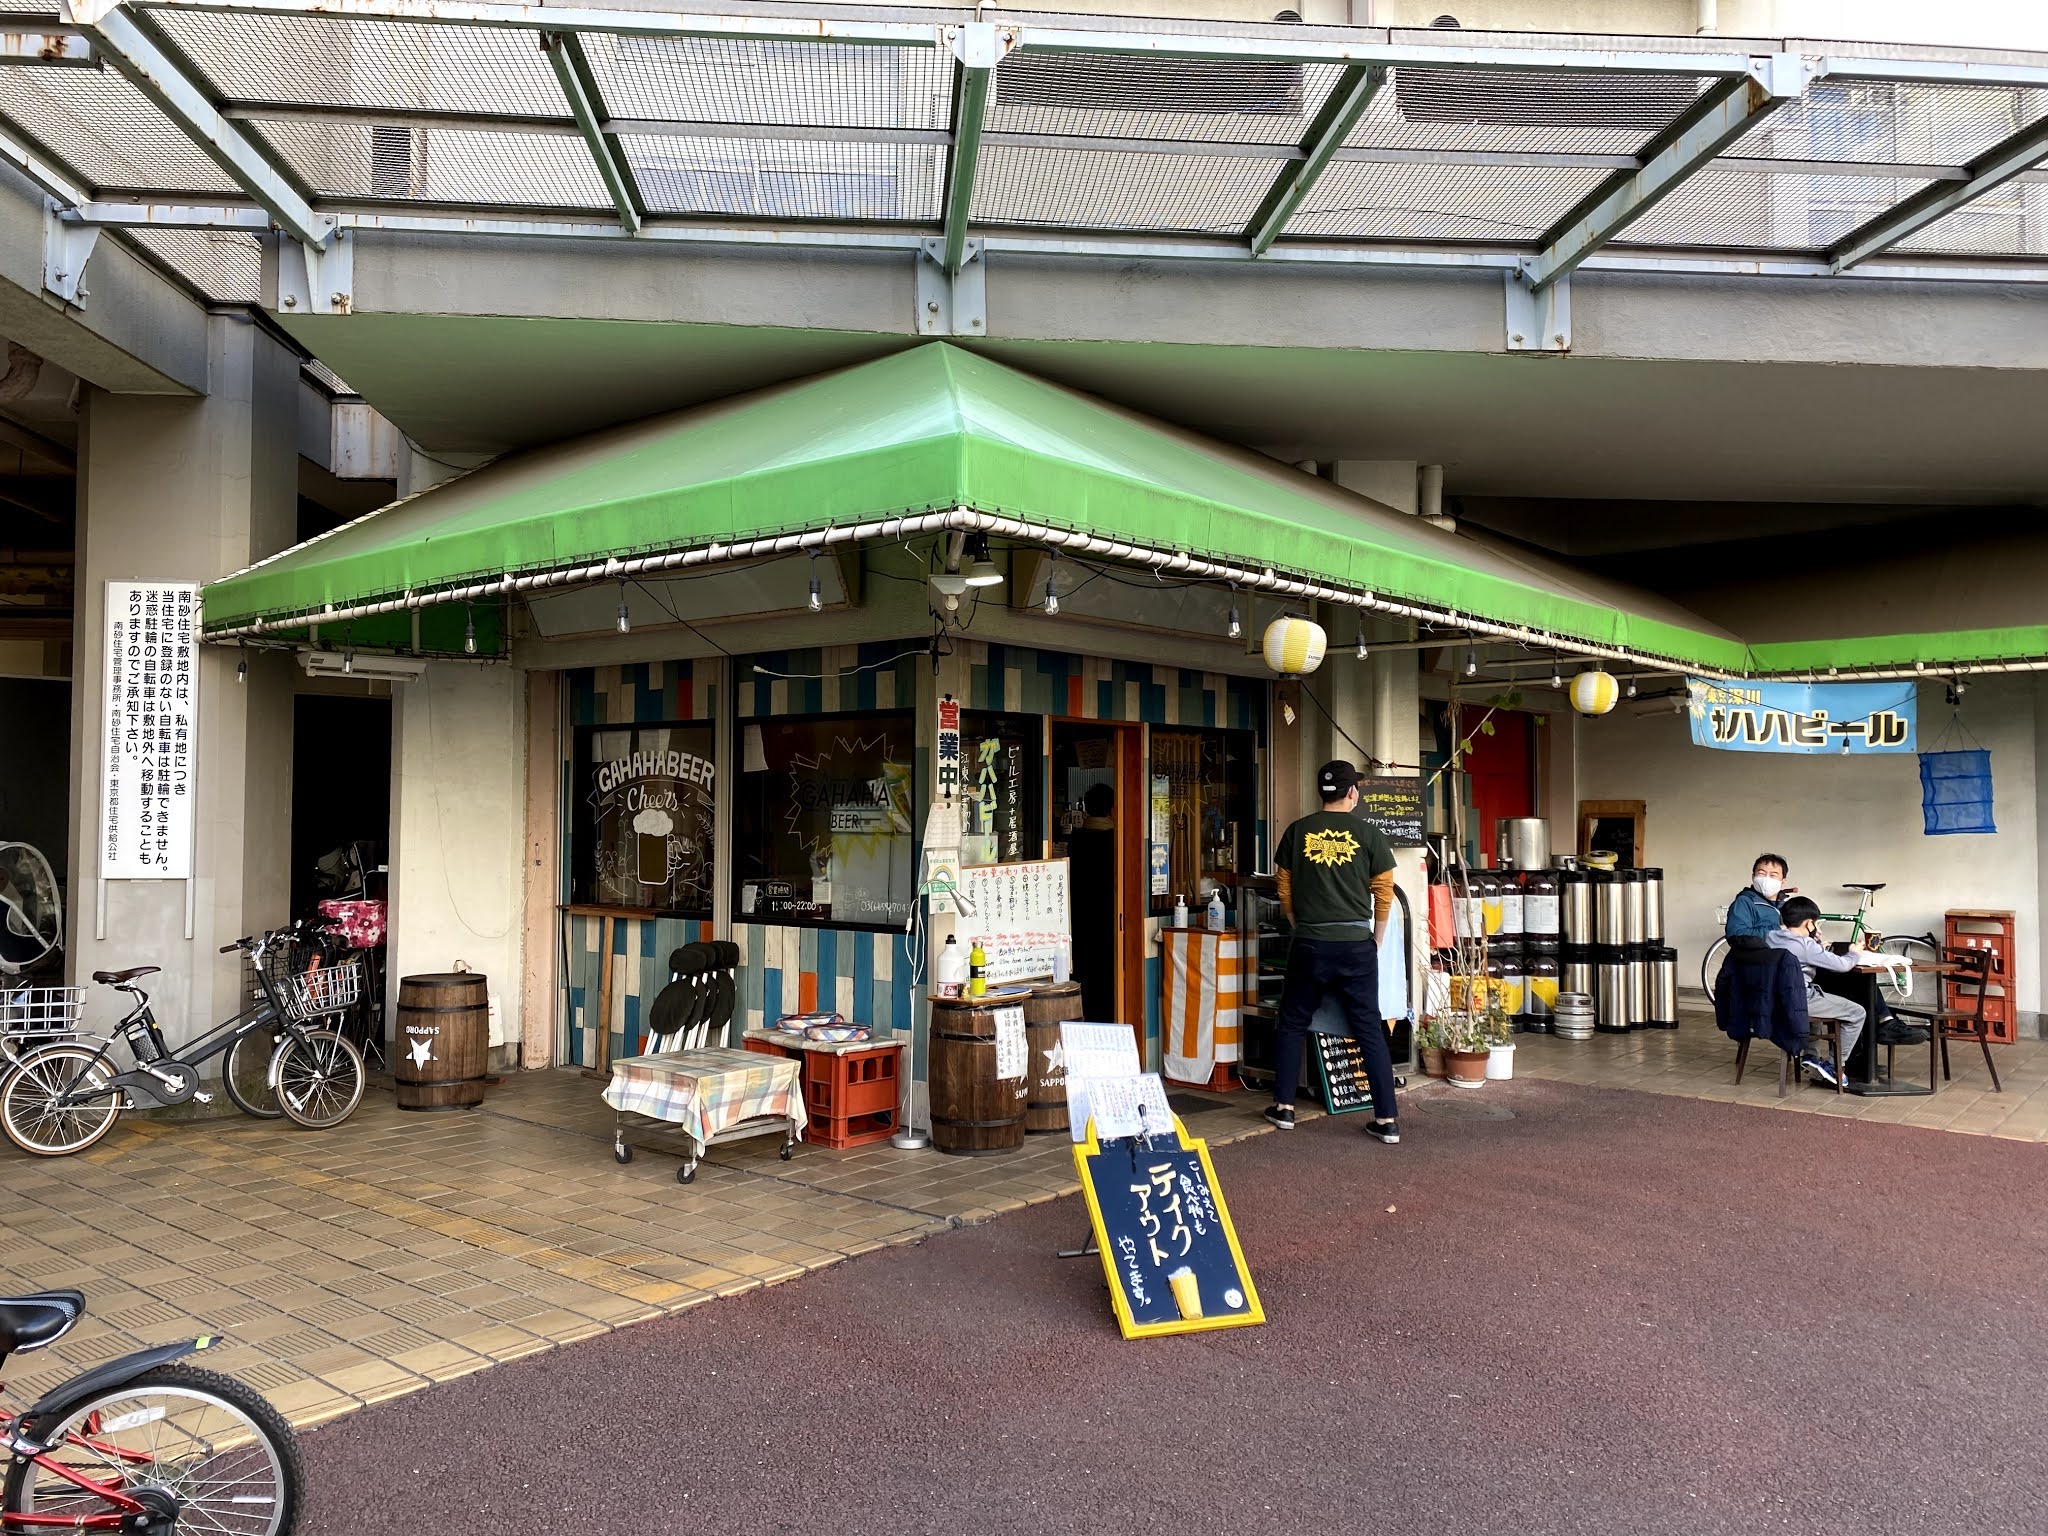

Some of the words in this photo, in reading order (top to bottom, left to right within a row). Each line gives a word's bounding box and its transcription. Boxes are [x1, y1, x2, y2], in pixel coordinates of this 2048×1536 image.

[125, 590, 142, 762] ありますのでご承知下さい。
[174, 590, 191, 796] 南砂住宅敷地内は、私有地につき
[1707, 688, 1761, 706] 東京深川
[139, 590, 158, 865] 迷惑駐輪の自転車は敷地外へ移動することも
[155, 590, 175, 872] 当住宅に登録のない自転車は駐輪できません。
[938, 700, 959, 794] 営業中
[1711, 706, 1908, 747] ガハハビール
[598, 750, 715, 793] GAHAHABEER
[627, 784, 679, 812] Cheers
[801, 781, 890, 807] GAHAHA
[978, 738, 1001, 862] ガハハビール
[1171, 785, 1188, 796] BEER
[831, 814, 859, 829] BEER
[405, 1025, 440, 1035] SAPPORO
[1130, 1183, 1169, 1267] アウト
[1148, 1162, 1192, 1257] テイク
[1179, 1174, 1206, 1236] 食べ物も
